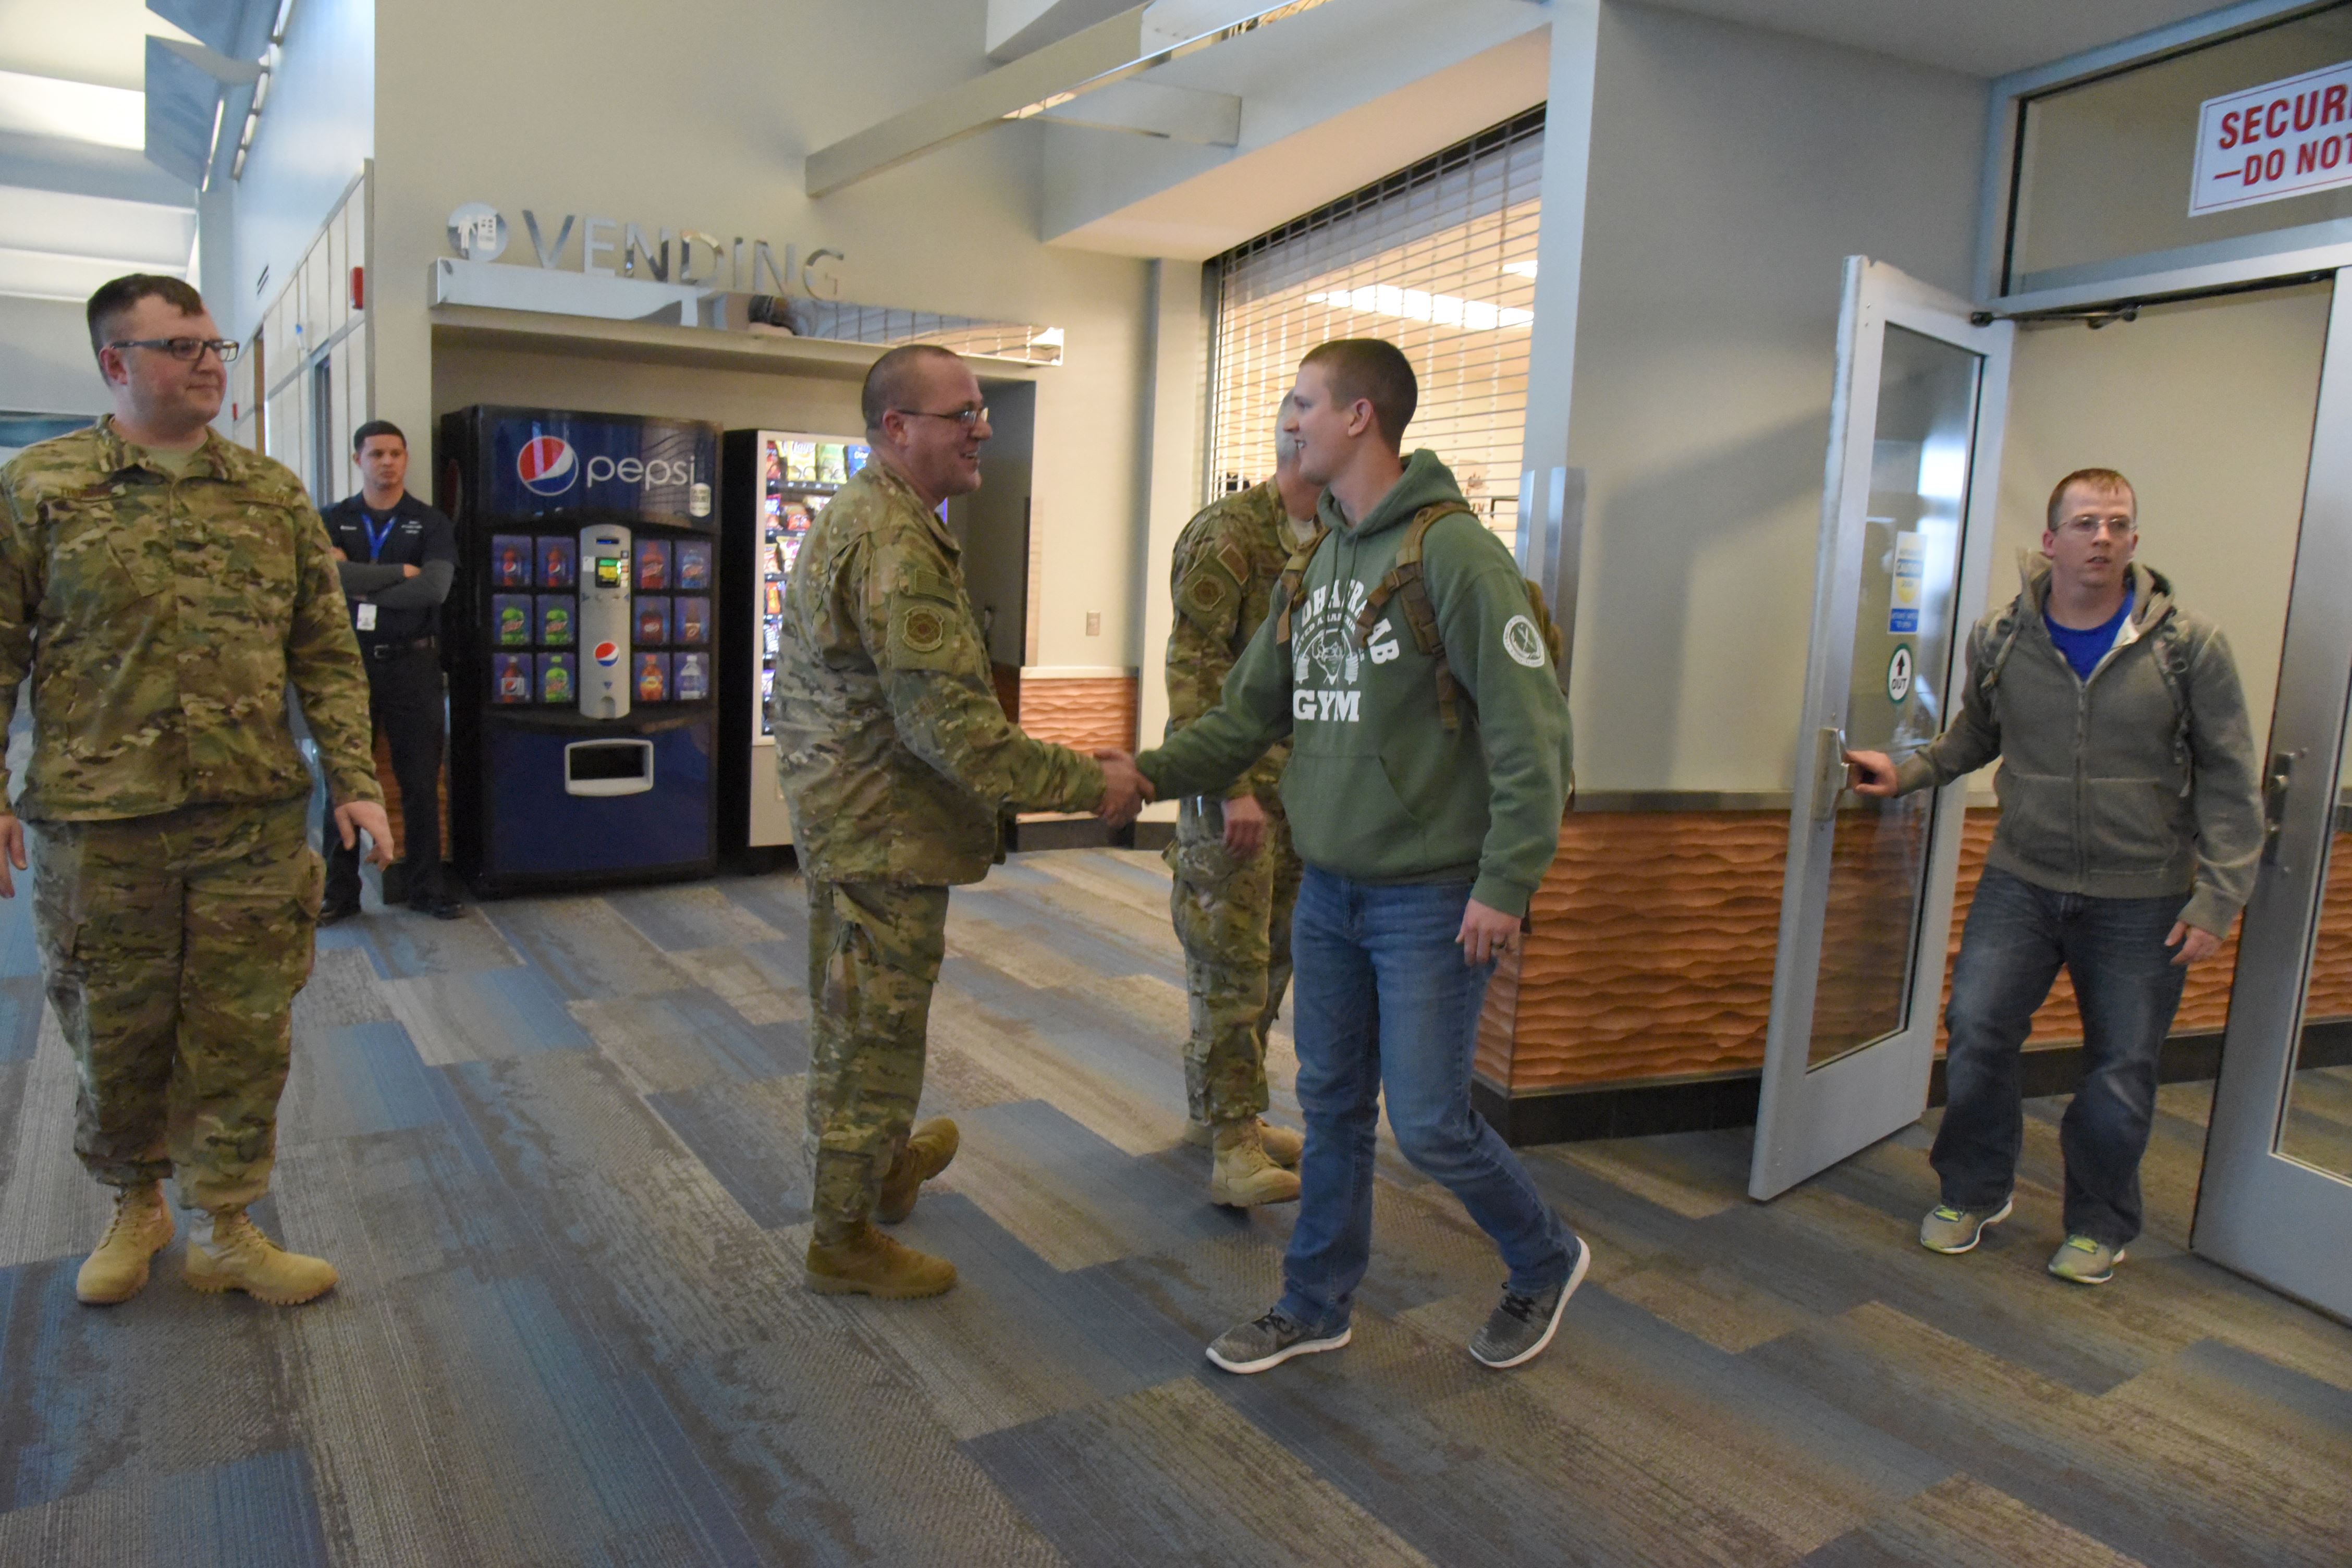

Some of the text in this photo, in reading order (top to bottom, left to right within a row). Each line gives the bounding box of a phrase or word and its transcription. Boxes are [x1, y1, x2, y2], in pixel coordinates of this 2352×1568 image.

[2219, 83, 2352, 150] SECUR
[523, 210, 844, 301] VENDING
[586, 455, 695, 491] pepsi
[1892, 678, 1907, 690] OUT
[1293, 689, 1361, 722] GYM
